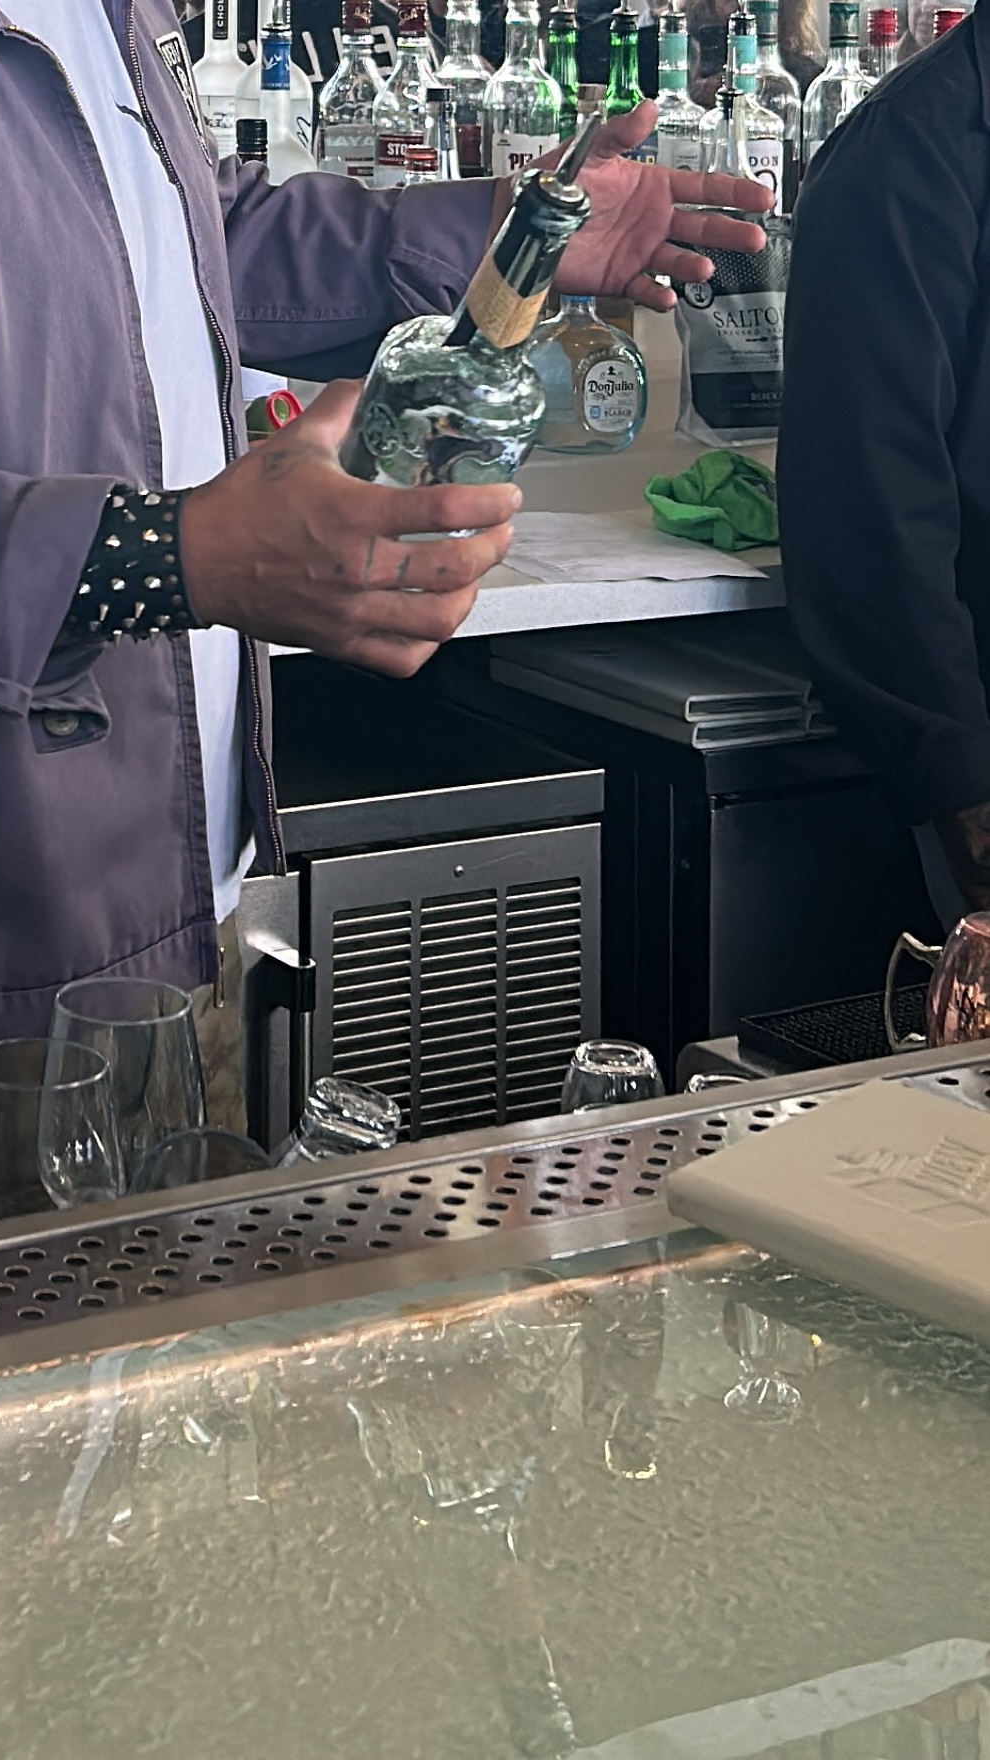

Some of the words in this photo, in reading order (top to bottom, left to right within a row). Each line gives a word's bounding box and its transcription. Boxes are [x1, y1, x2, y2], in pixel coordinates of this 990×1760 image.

[387, 142, 406, 156] STO
[749, 155, 779, 166] DON
[713, 306, 783, 328] SALTO
